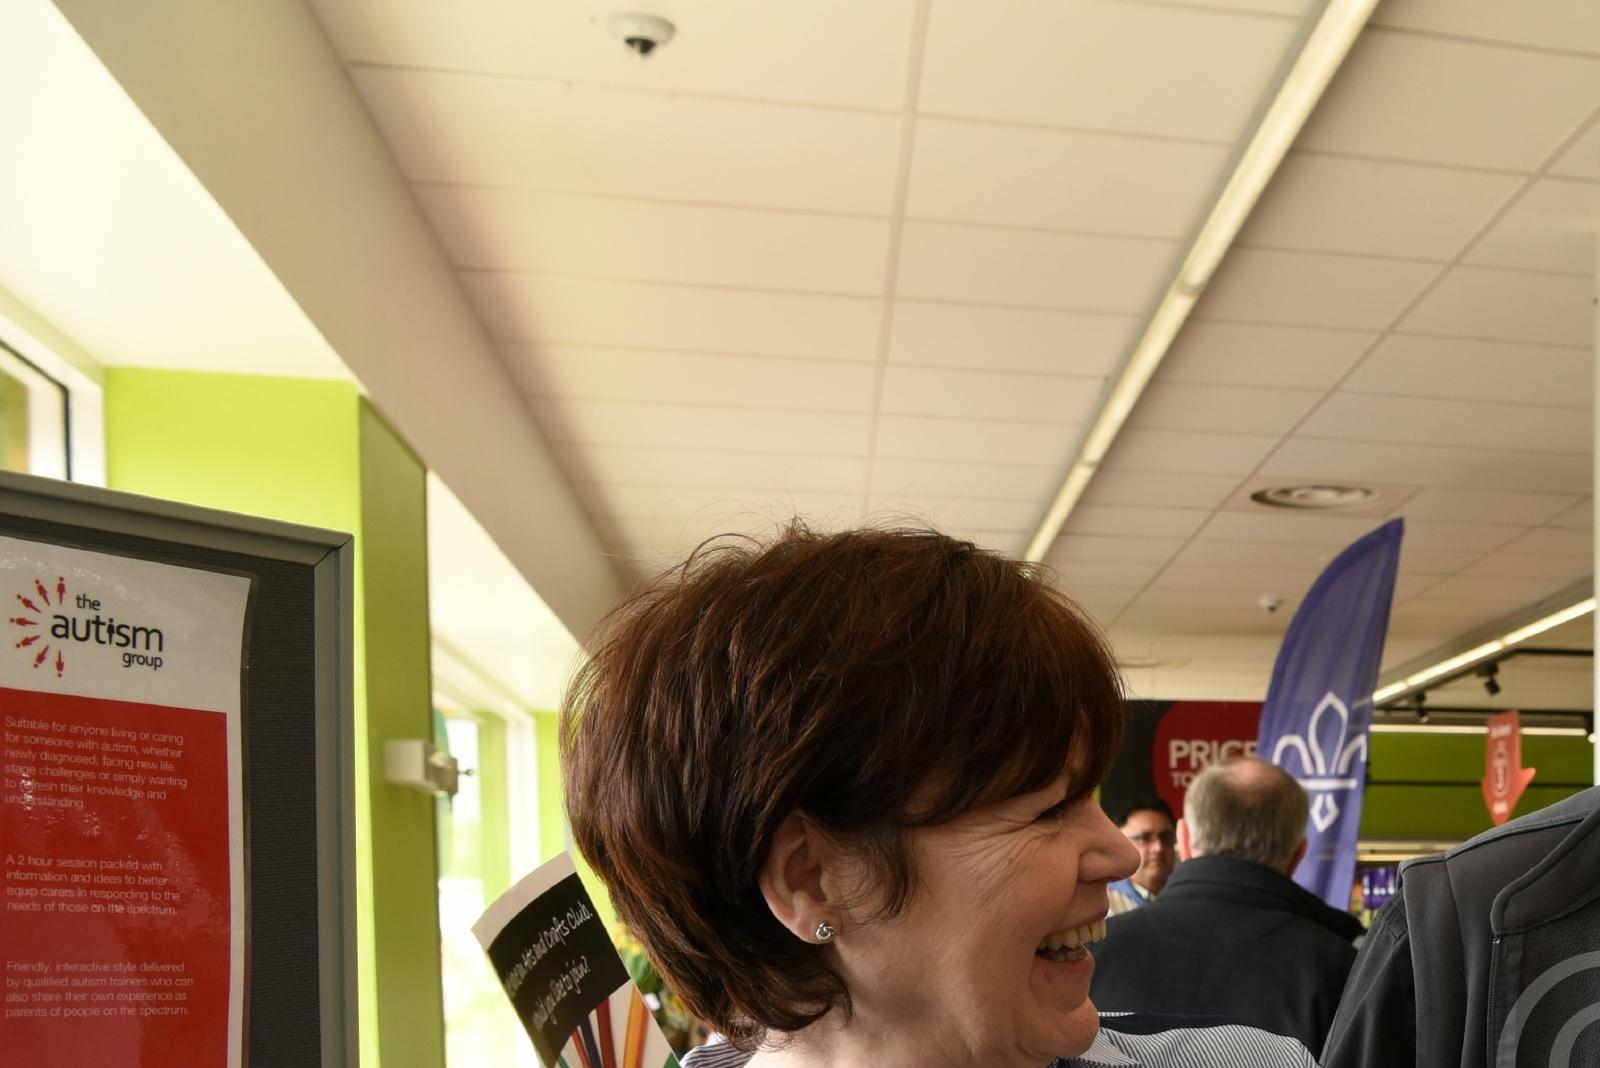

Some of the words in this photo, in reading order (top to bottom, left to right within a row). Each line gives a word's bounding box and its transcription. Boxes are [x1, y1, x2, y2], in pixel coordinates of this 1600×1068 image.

[76, 593, 101, 611] the
[51, 612, 163, 652] autism
[122, 650, 163, 671] group
[5, 716, 49, 730] Suitable
[52, 721, 66, 732] for
[69, 723, 108, 736] anyone
[111, 728, 136, 741] living
[139, 732, 150, 740] or
[152, 733, 183, 745] caring
[5, 732, 19, 742] for
[23, 734, 73, 748] someone
[77, 739, 99, 750] with
[102, 742, 139, 755] autism,
[142, 746, 183, 758] whether
[5, 749, 36, 761] newly
[102, 756, 133, 770] facing
[137, 760, 158, 769] new
[160, 759, 174, 771] life
[566, 901, 593, 929] Club.
